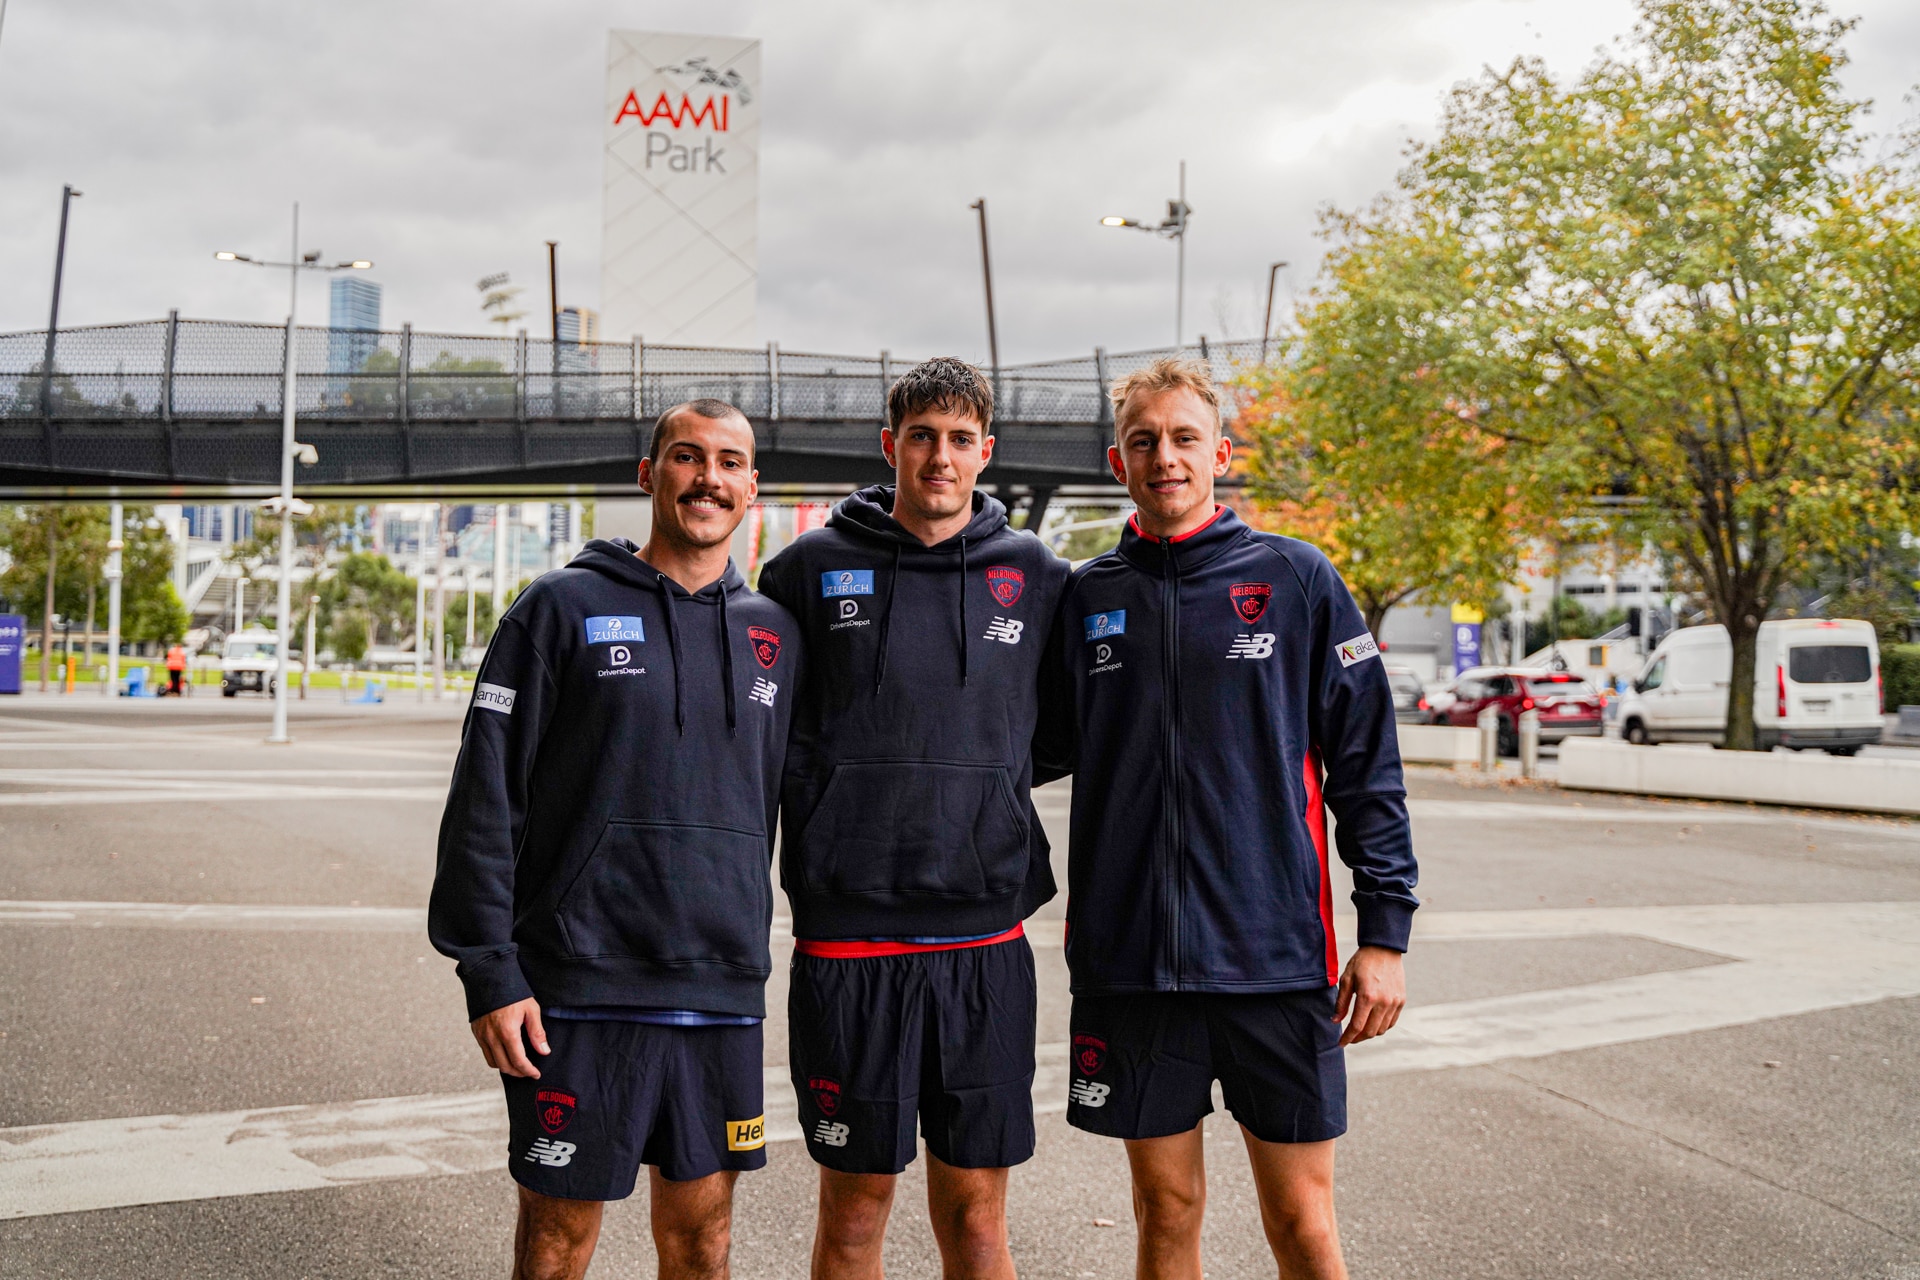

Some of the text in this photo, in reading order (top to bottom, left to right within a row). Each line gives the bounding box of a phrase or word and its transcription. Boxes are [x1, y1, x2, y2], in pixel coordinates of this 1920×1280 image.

[613, 88, 729, 132] AAMI
[645, 131, 726, 174] Park
[988, 569, 1024, 582] MELBOURNE
[827, 584, 868, 595] ZURICH
[1232, 586, 1270, 597] MELBOURNE
[830, 619, 871, 630] DriversDepot
[592, 630, 640, 641] ZURICH
[750, 629, 780, 647] MELBOURNE
[1087, 624, 1120, 640] ZURICH
[597, 667, 646, 677] DriversDepot
[538, 1090, 577, 1109] MELBOURNE
